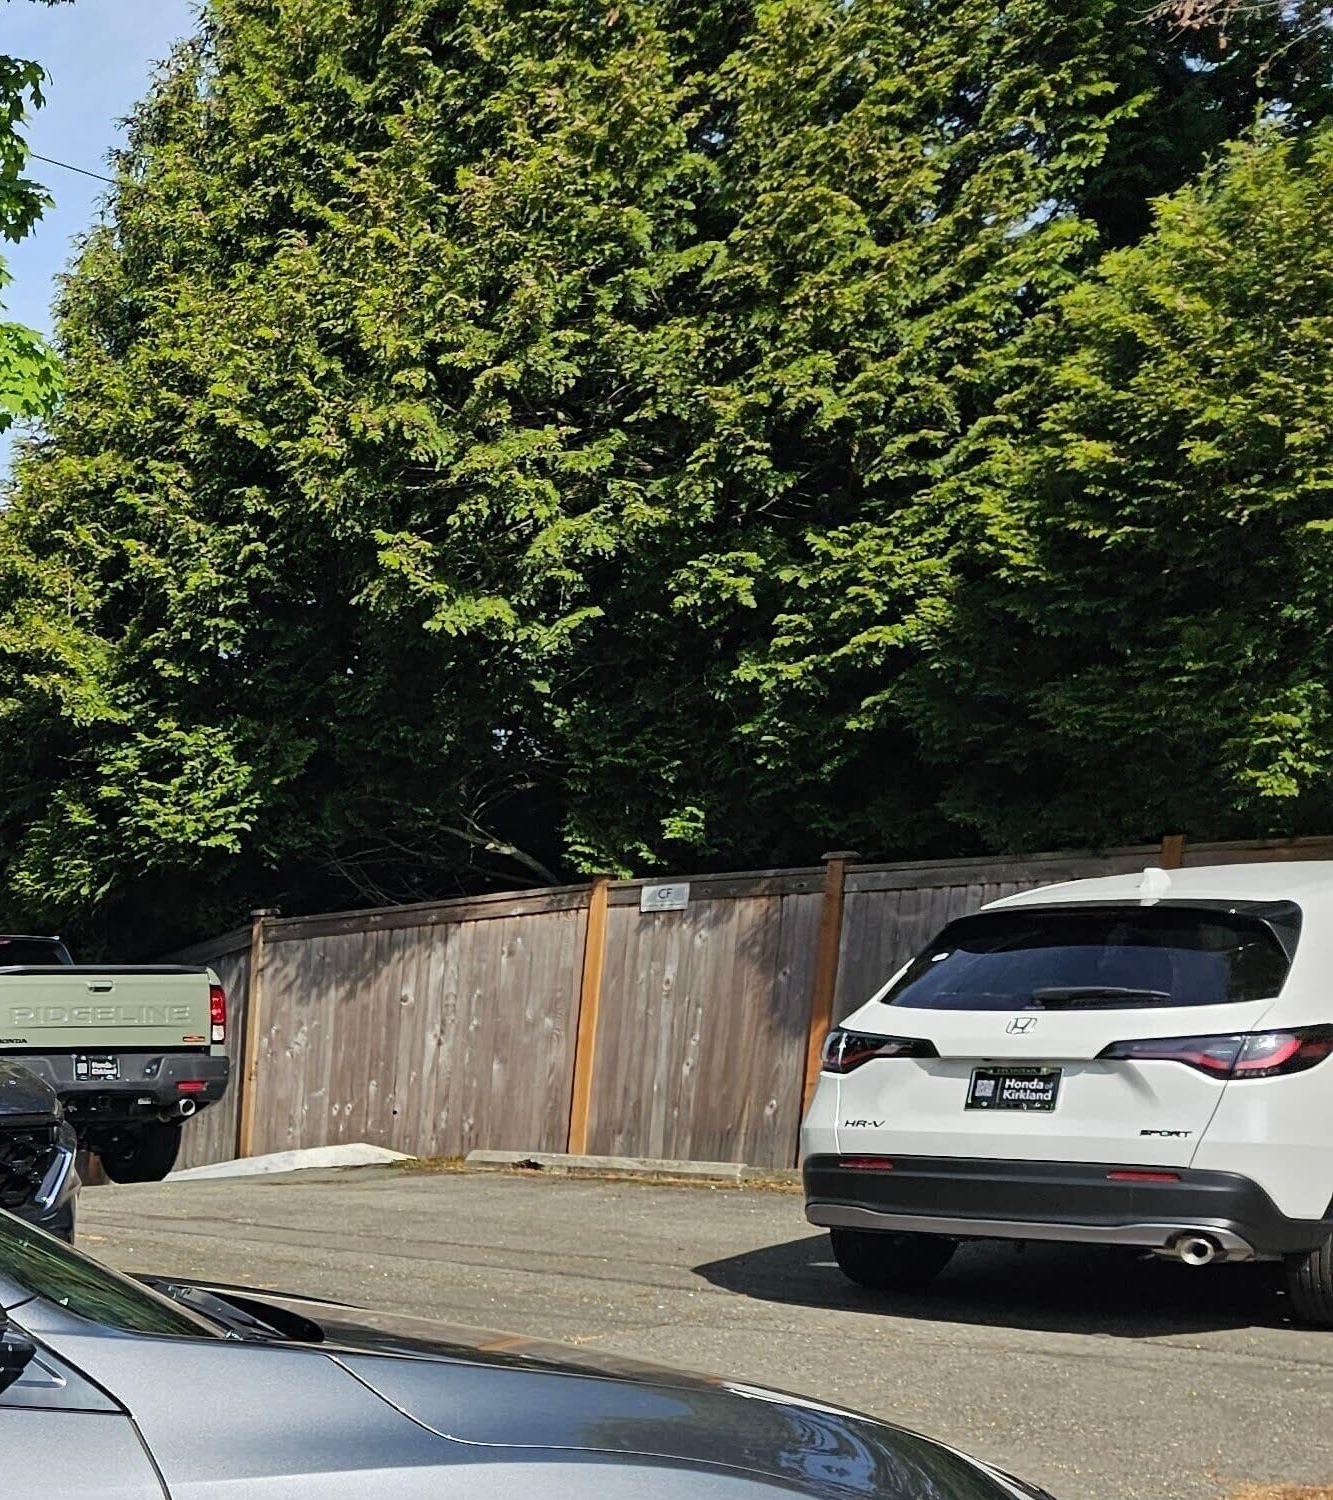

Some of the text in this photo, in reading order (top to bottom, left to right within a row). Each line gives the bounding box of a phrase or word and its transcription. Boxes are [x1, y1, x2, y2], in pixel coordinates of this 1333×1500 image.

[10, 1005, 191, 1025] RIDGELINE
[1004, 1078, 1044, 1090] Honda
[1002, 1089, 1053, 1101] Kirkland
[844, 1119, 886, 1128] HR-V
